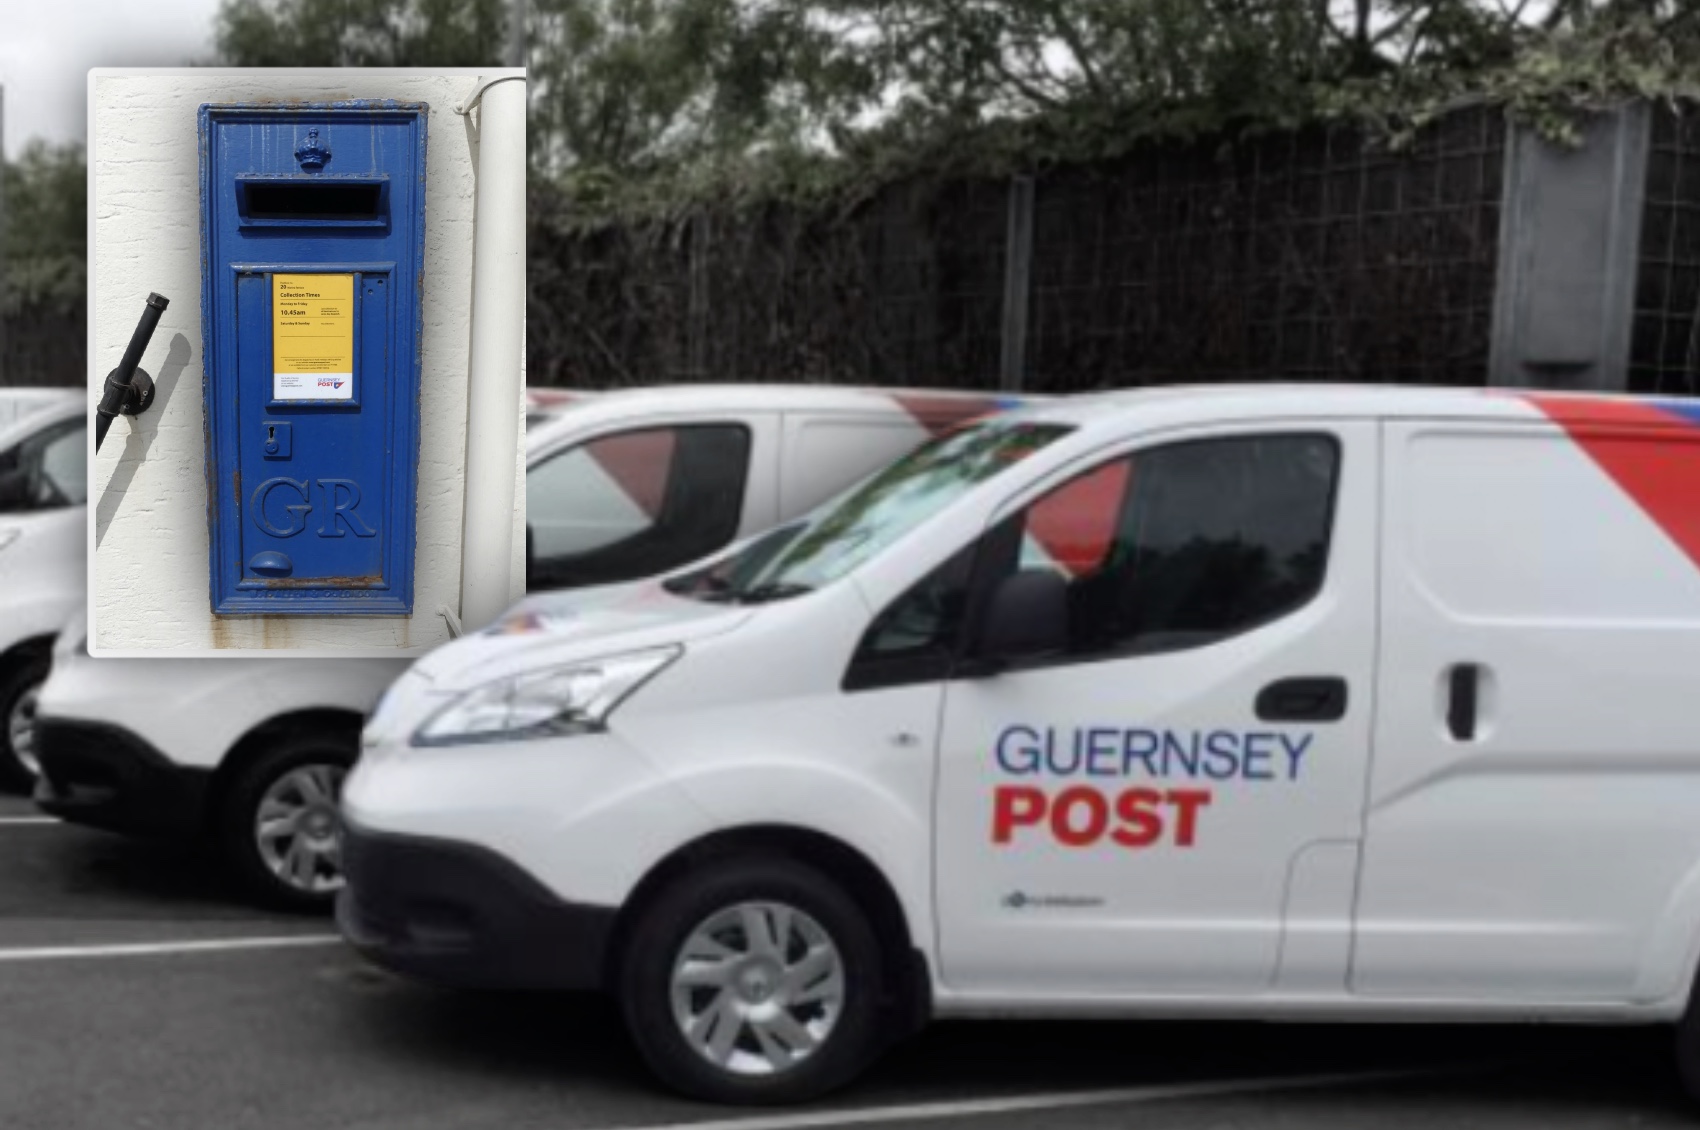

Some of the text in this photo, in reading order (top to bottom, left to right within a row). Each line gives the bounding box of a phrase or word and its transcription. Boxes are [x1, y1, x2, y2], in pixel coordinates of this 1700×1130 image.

[250, 476, 376, 538] GR
[996, 725, 1313, 780] GUERNSEY
[992, 785, 1211, 847] POST
